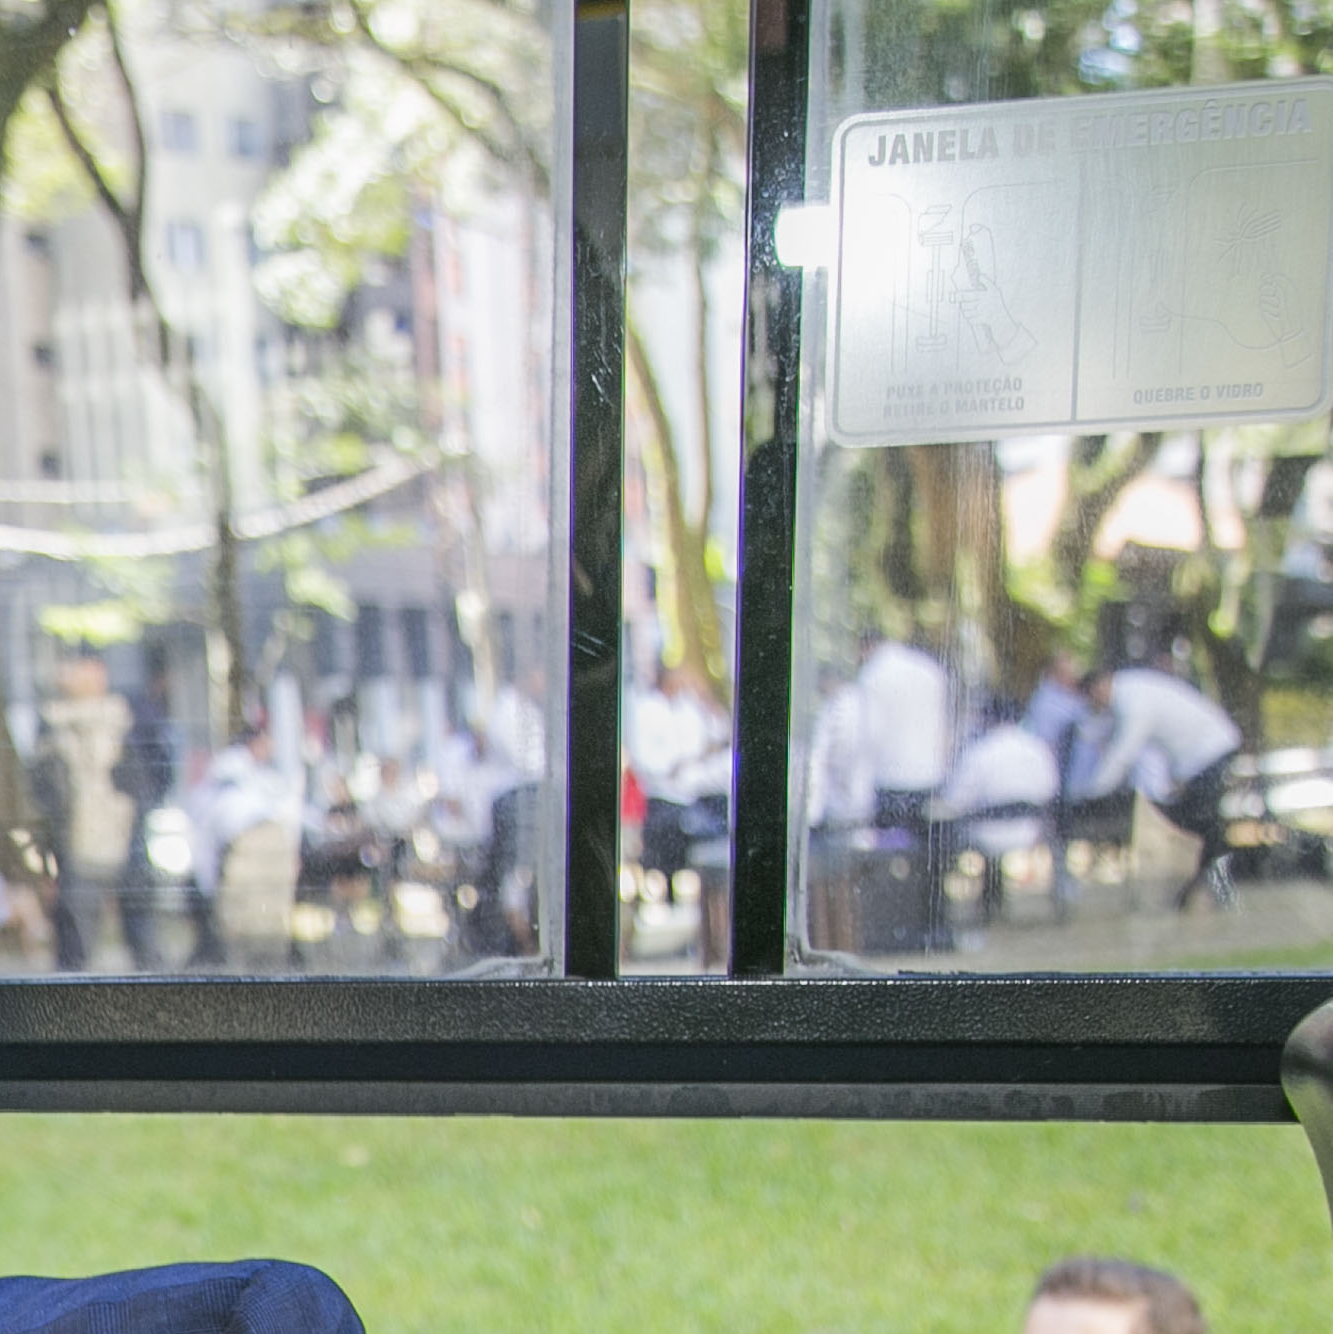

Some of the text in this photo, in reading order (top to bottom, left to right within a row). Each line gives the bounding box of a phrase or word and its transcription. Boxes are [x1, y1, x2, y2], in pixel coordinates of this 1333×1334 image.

[867, 98, 1314, 167] JANELA DE EMERGÊNCIA
[943, 374, 1023, 396] PROTEÇÃO
[1132, 382, 1264, 405] QUEBRE O VIDRO
[955, 396, 1025, 414] MARTELO
